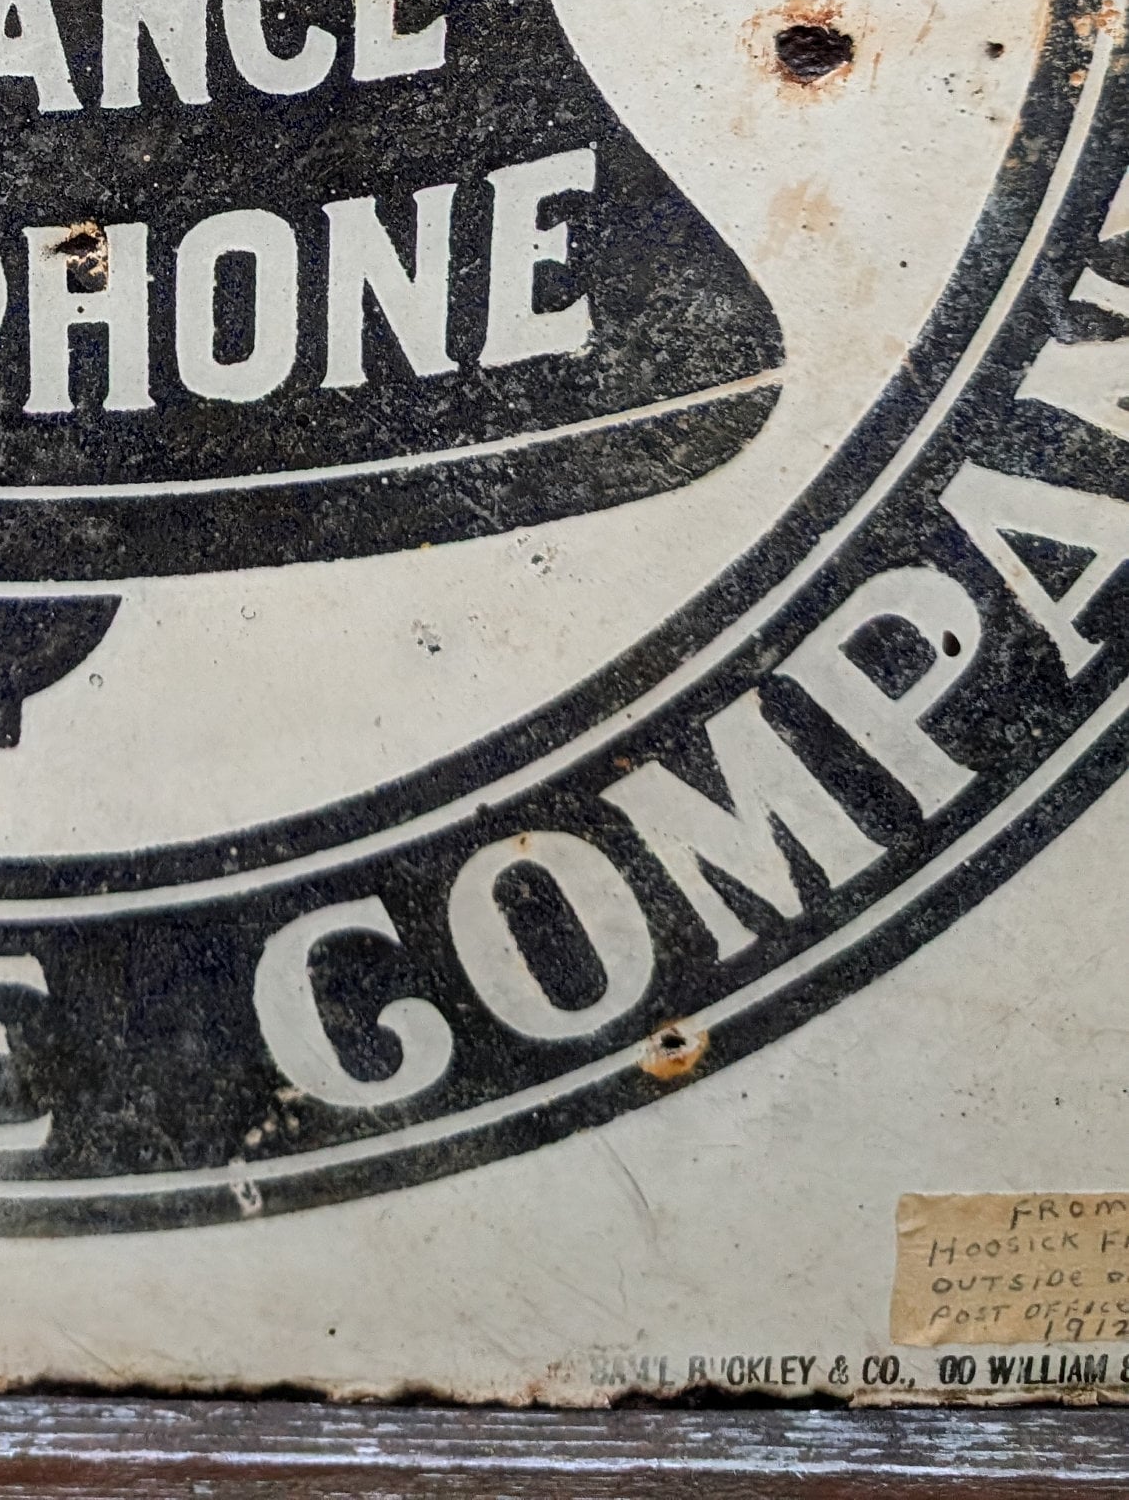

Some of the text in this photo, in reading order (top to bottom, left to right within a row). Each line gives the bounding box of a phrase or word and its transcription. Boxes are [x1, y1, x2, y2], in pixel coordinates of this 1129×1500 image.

[928, 1230, 1080, 1268] HOOSICK
[930, 1304, 1011, 1326] POST
[828, 1354, 849, 1385] &
[861, 1354, 916, 1388] CO.,
[987, 1352, 1109, 1385] WILLIAM
